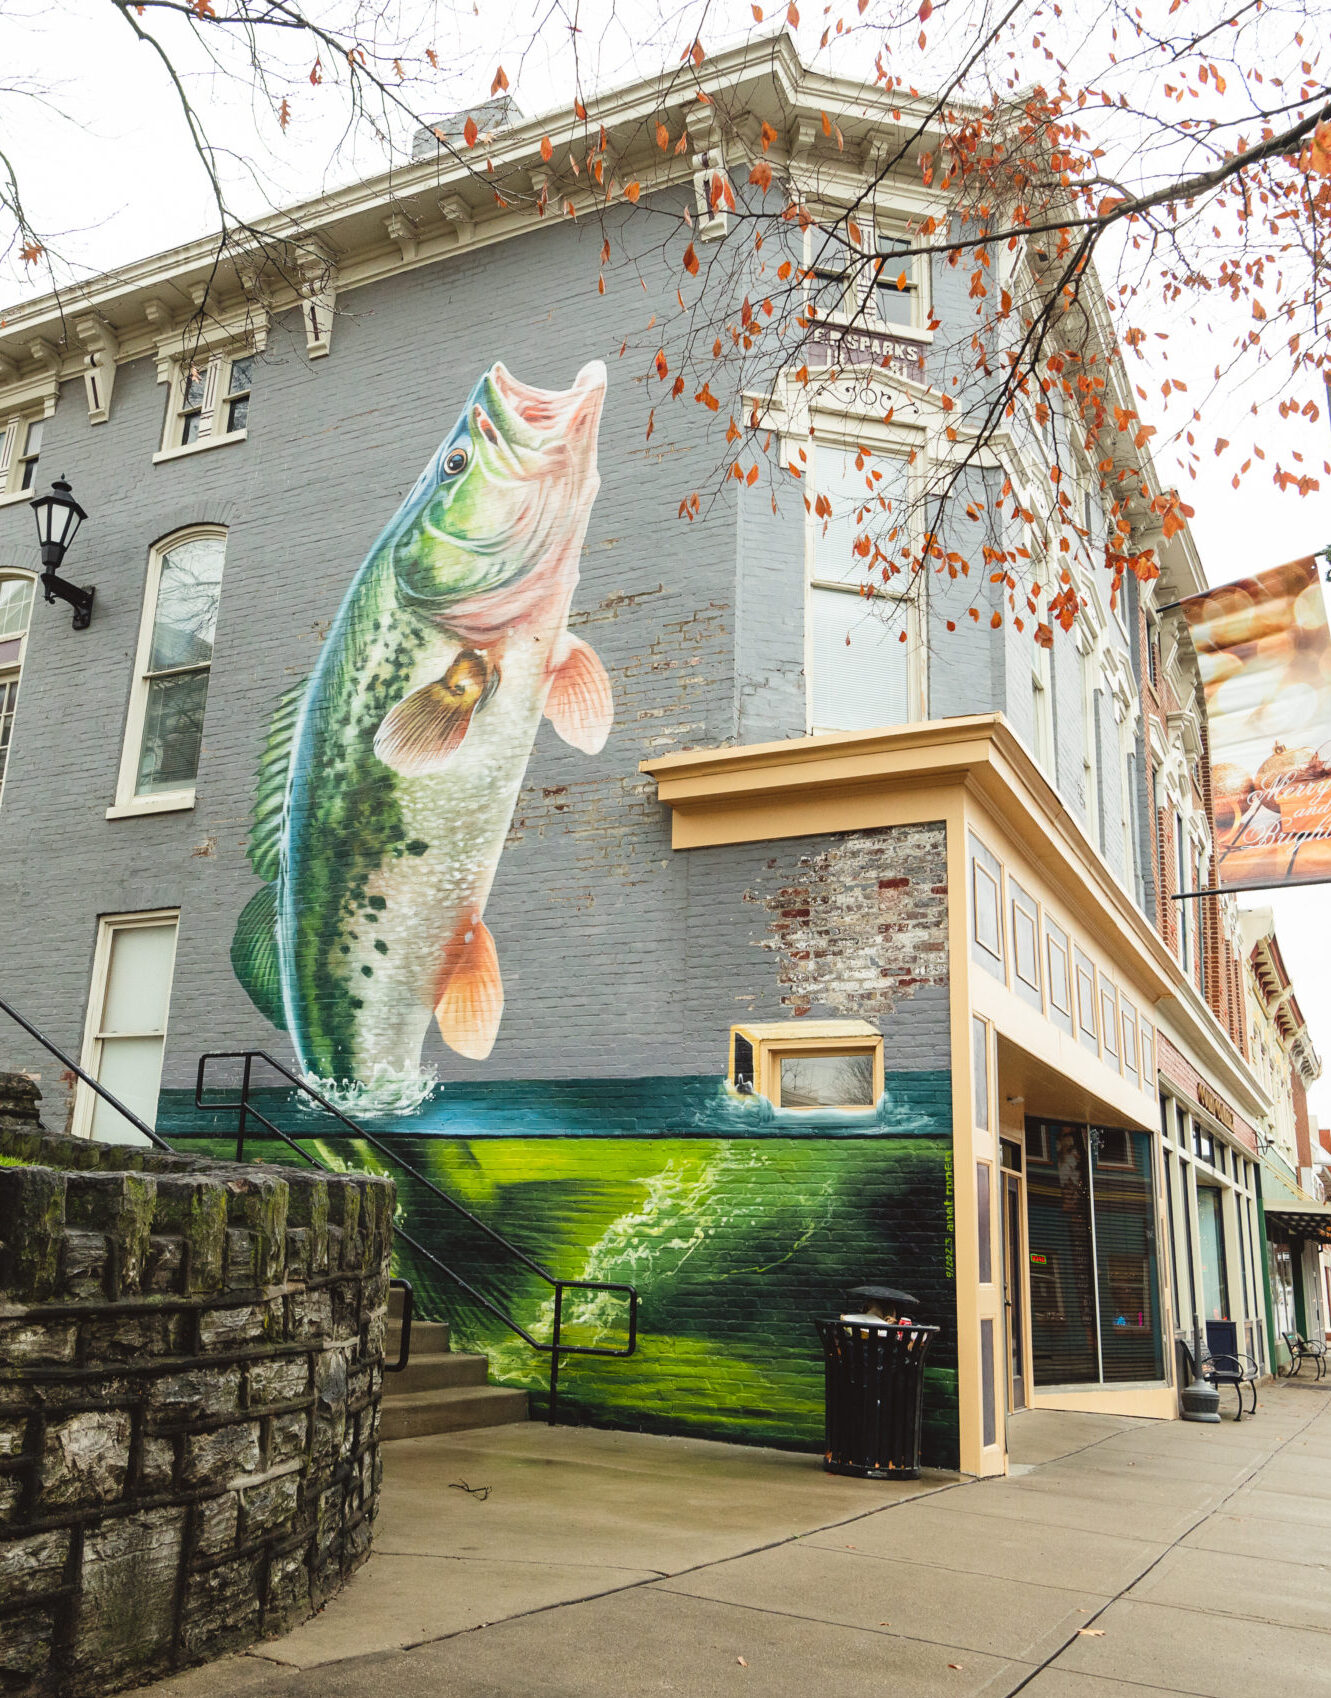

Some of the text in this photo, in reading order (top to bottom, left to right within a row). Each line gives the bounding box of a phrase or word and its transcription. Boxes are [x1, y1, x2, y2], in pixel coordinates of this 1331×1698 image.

[847, 334, 918, 361] SPARKS
[1247, 771, 1331, 805] Merry
[1293, 799, 1331, 818] and
[944, 1200, 954, 1232] anat
